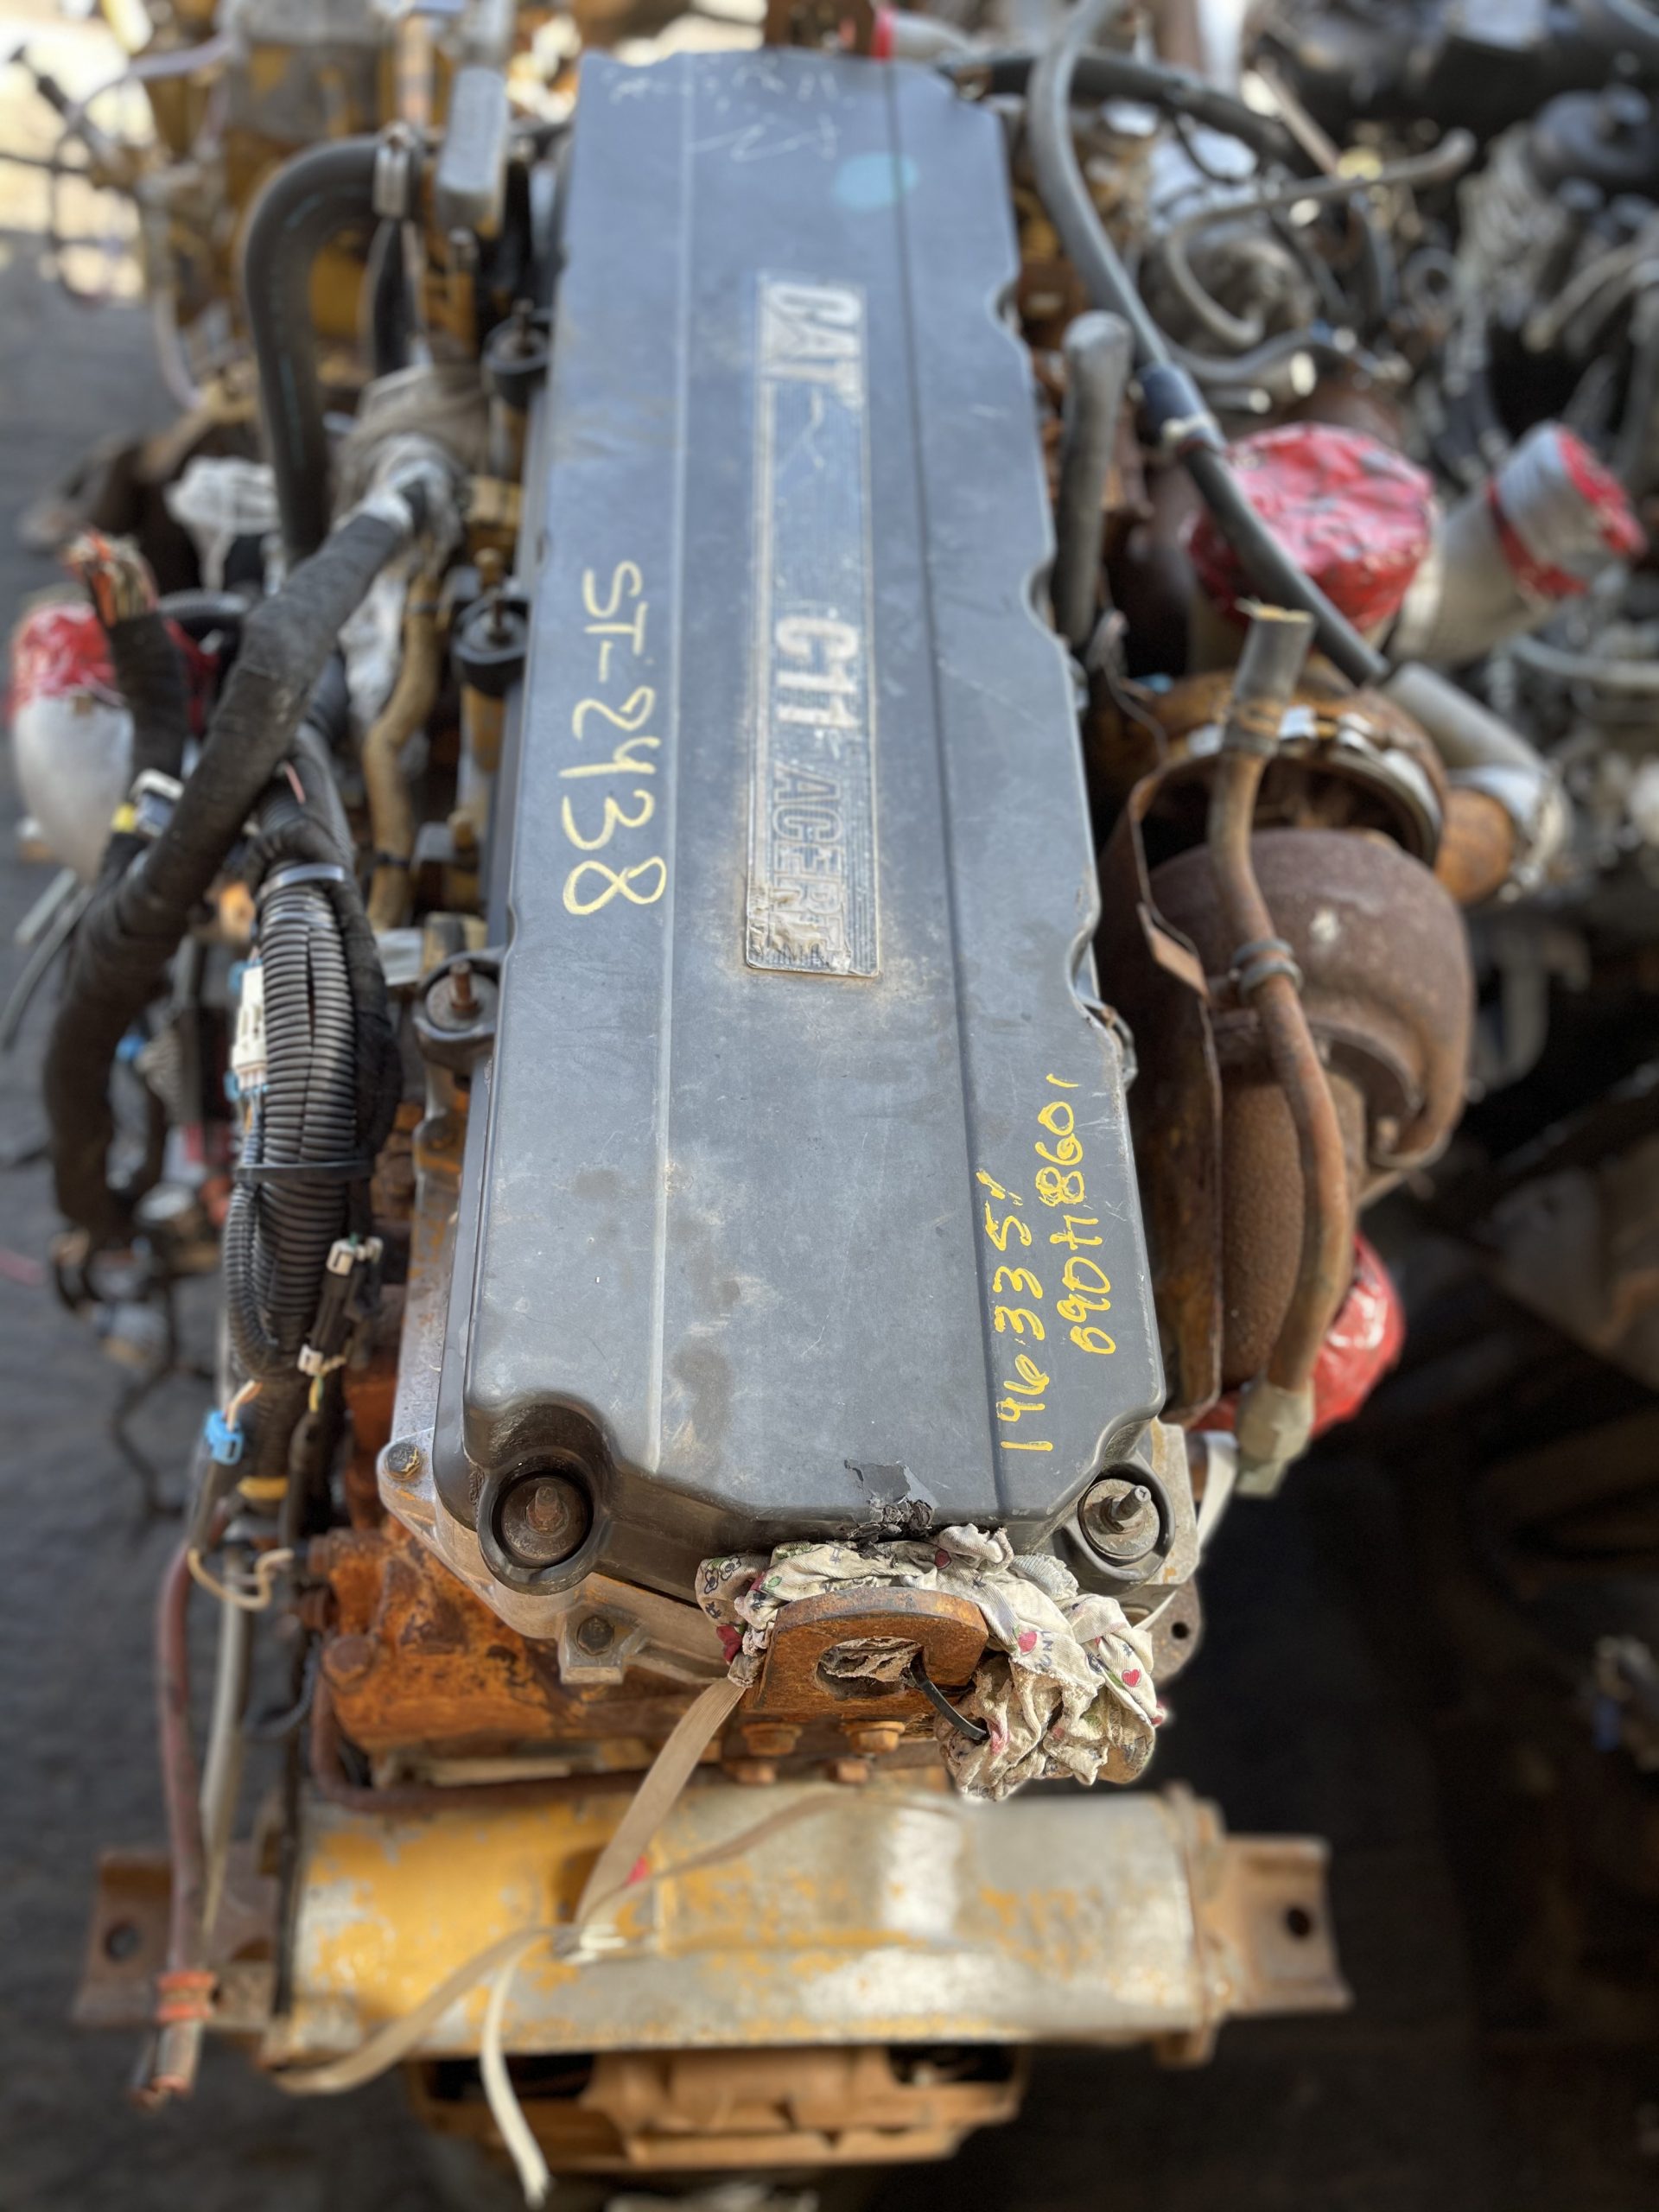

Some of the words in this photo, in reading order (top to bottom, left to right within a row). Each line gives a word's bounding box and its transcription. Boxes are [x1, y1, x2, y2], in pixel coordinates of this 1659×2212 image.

[768, 283, 863, 399] CAT
[777, 615, 861, 729] C11
[559, 561, 667, 915] ST-2438
